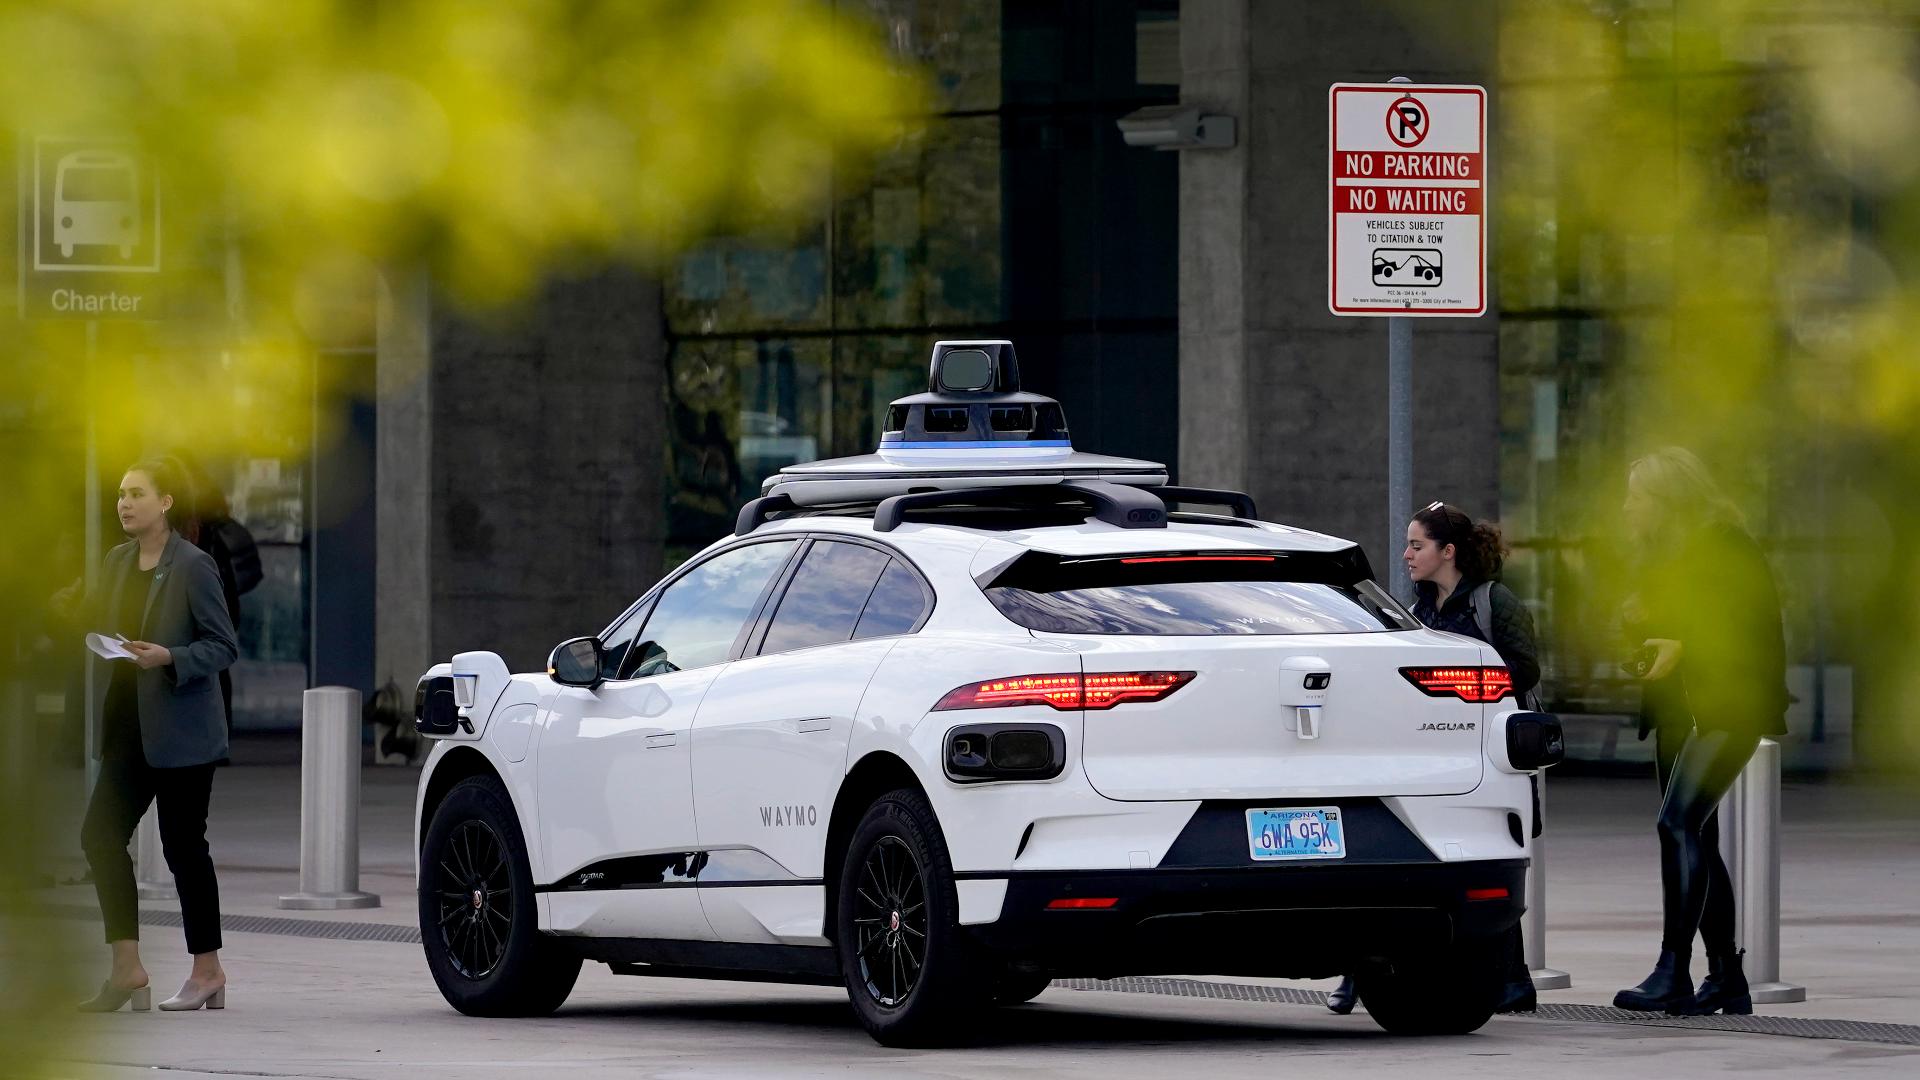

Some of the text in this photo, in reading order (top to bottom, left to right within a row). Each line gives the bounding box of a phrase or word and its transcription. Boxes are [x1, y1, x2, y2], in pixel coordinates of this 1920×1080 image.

[1346, 154, 1470, 177] NO PARKING
[1350, 189, 1466, 212] NO WAITING
[1366, 220, 1444, 231] VEHICLES SUBJECT
[1368, 234, 1443, 244] TO CITATION & TOW
[51, 288, 142, 312] Charter
[1236, 616, 1315, 624] WAYMO
[1416, 722, 1476, 731] JAGUAR
[759, 805, 817, 827] WAYMO
[1261, 822, 1332, 849] 6WA 95K
